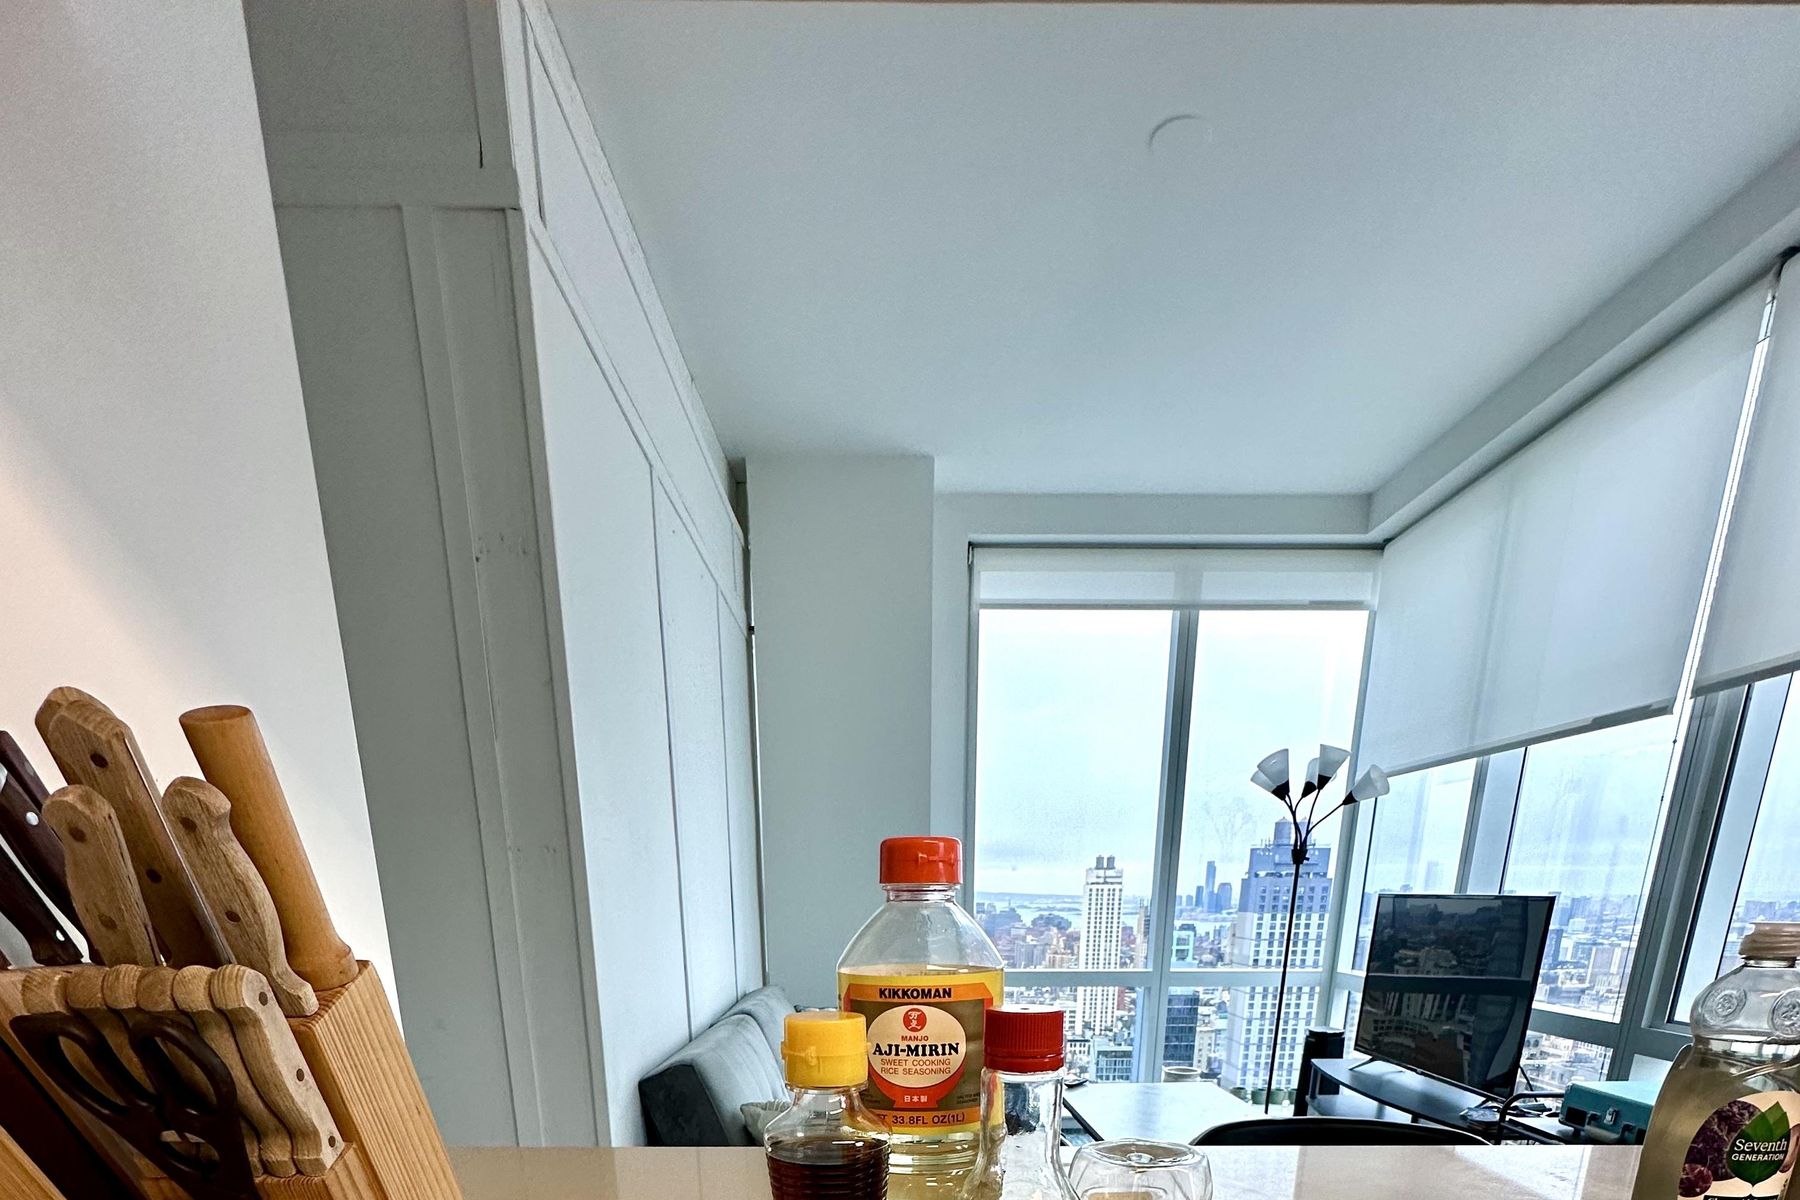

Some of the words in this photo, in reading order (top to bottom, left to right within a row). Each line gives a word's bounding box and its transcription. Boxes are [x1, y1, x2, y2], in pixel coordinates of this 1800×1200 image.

[879, 988, 952, 1000] KIKKOMAN
[872, 1042, 960, 1057] AJI-MIRIN
[880, 1058, 908, 1067] SWEET
[912, 1058, 950, 1067] COOKING
[902, 1067, 950, 1076] SEASONING
[904, 1095, 928, 1103] 日本製
[892, 1115, 928, 1125] 33.8FL
[932, 1112, 965, 1124] OZ(1L)
[1734, 1138, 1788, 1151] Seventh
[1732, 1153, 1784, 1162] GENERATION
